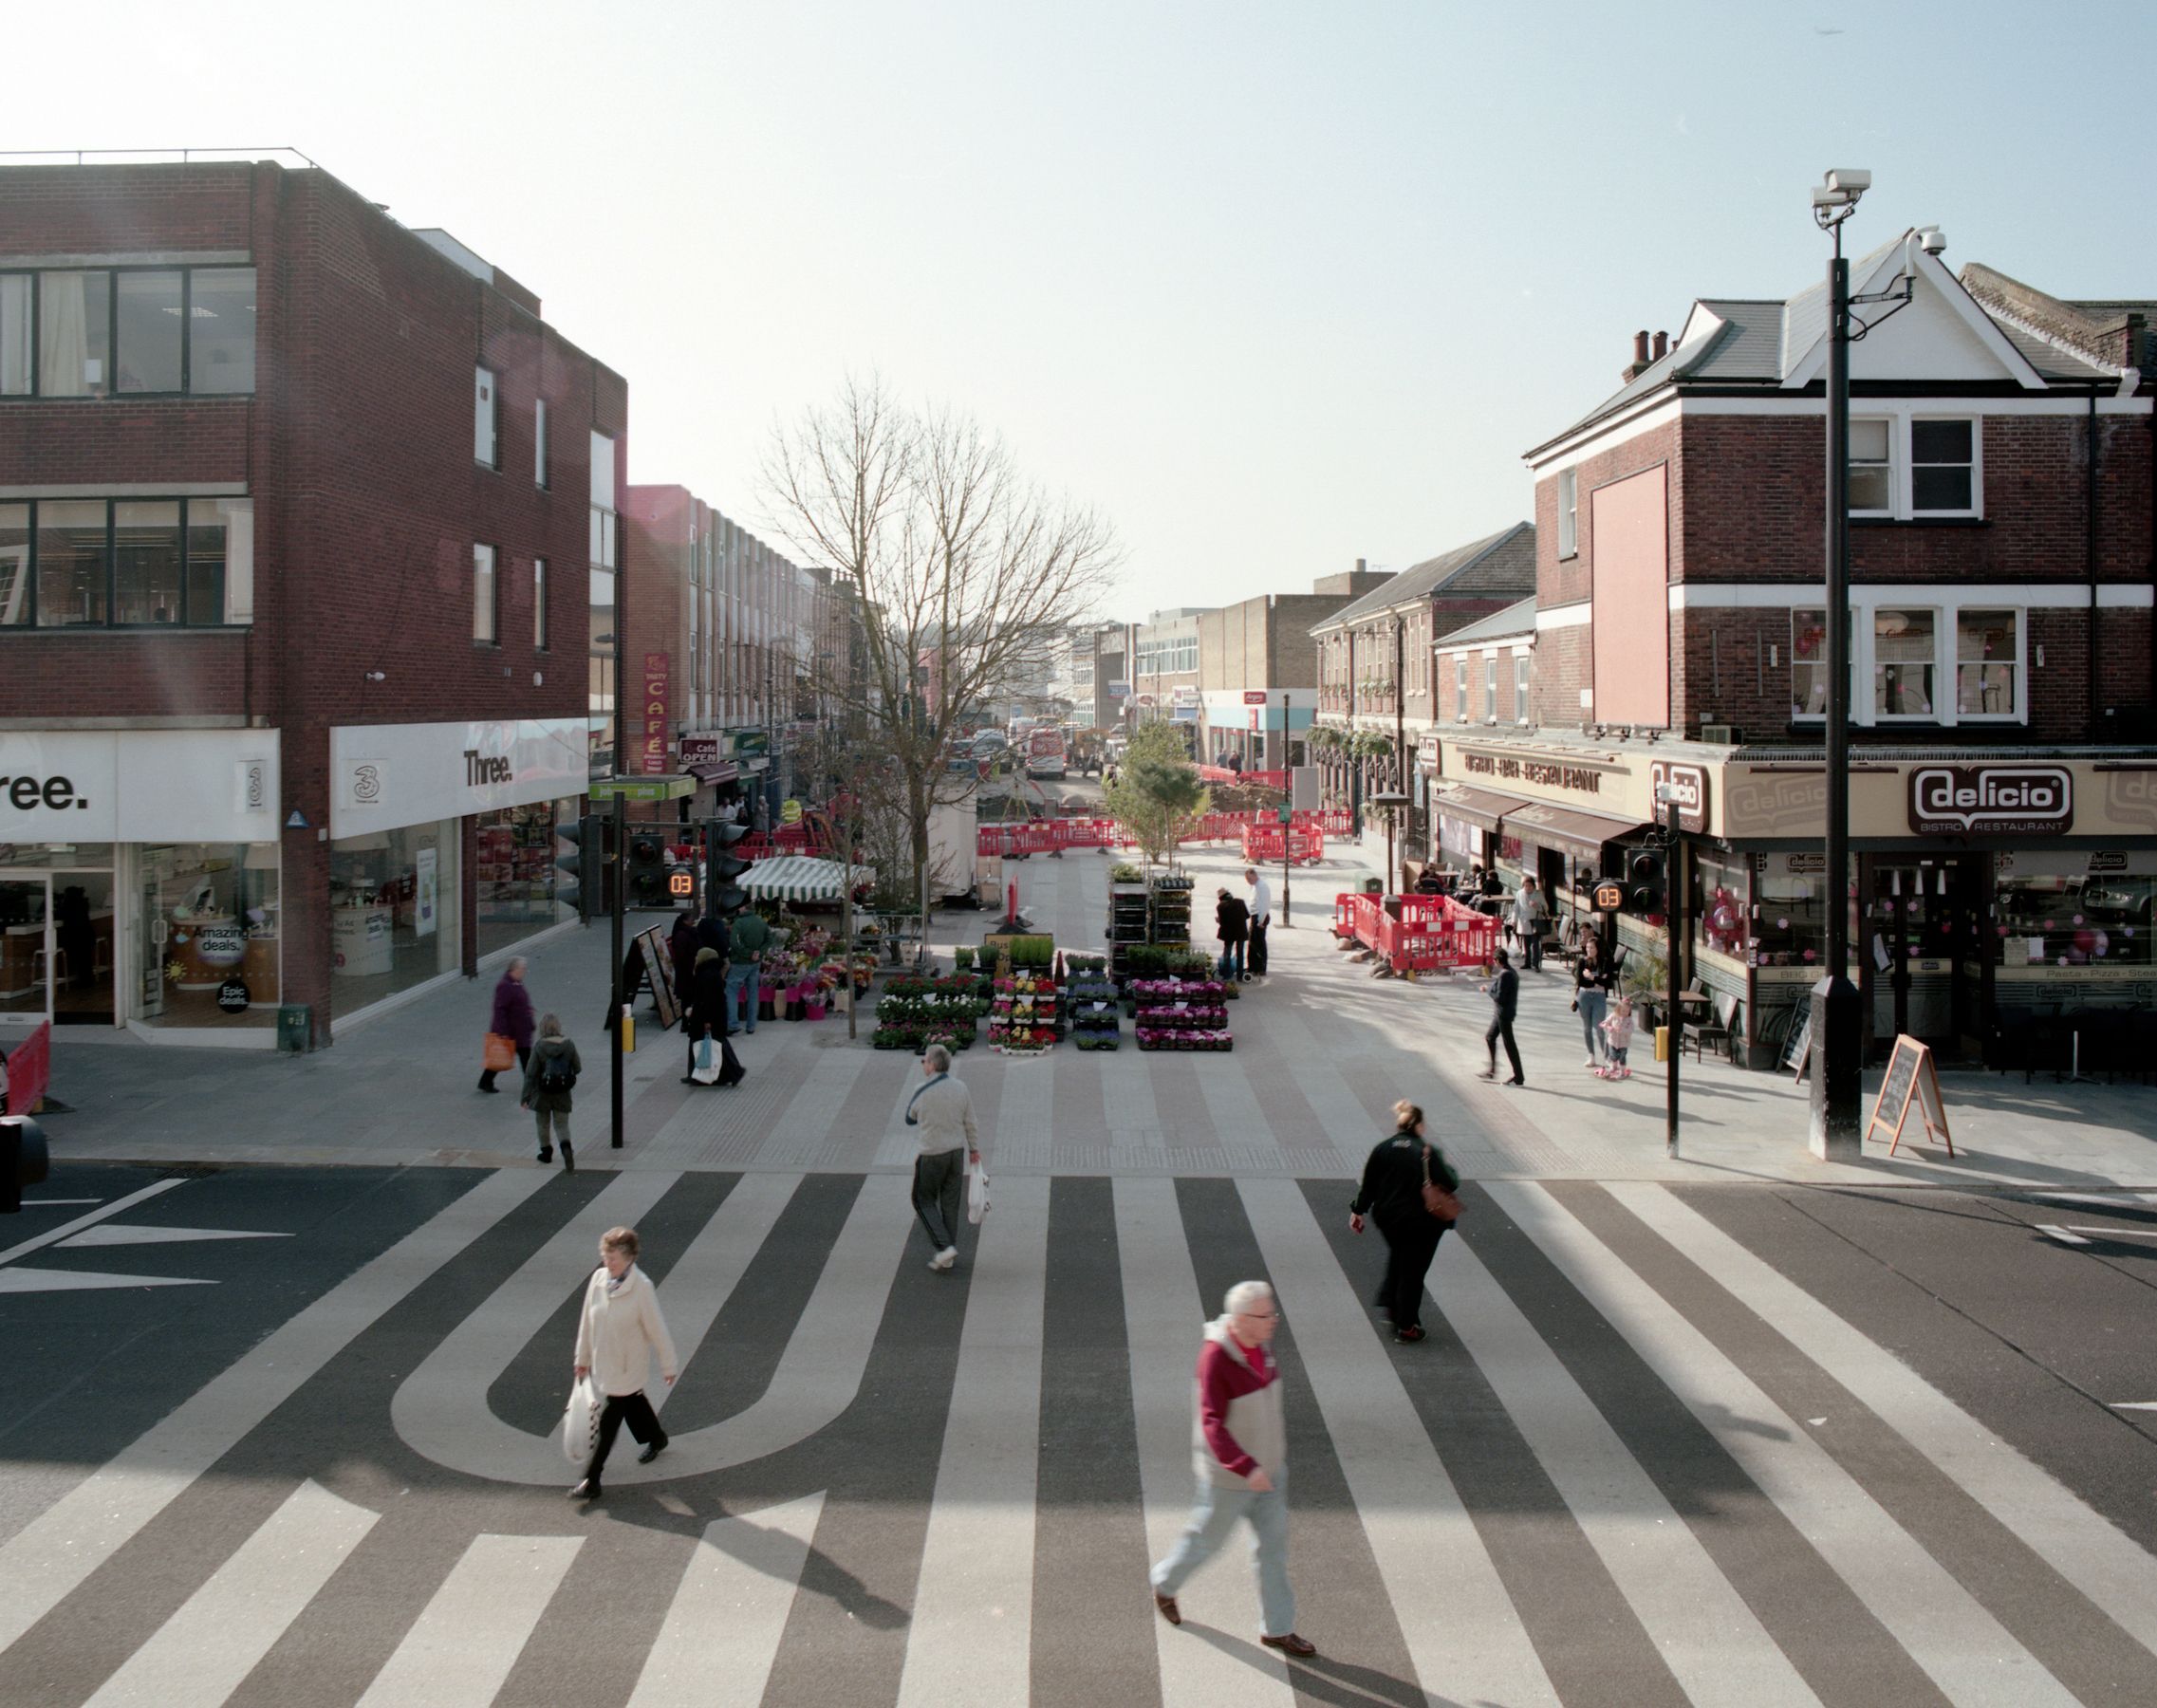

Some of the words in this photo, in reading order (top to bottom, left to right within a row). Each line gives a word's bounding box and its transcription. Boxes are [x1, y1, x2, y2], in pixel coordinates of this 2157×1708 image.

[648, 682, 664, 752] CAFÉ
[463, 751, 513, 787] Three.
[1525, 762, 1601, 793] RESTAURANT
[1930, 777, 2054, 808] delicio
[1920, 823, 1962, 832] BISTRO
[1974, 822, 2064, 831] RESTAURANT
[1791, 855, 1825, 865] delicio
[671, 875, 692, 893] 03
[1599, 888, 1620, 907] 03
[194, 926, 249, 941] Amazing
[202, 939, 242, 951] deals.
[2129, 969, 2157, 977] Stea
[222, 986, 246, 999] Epic
